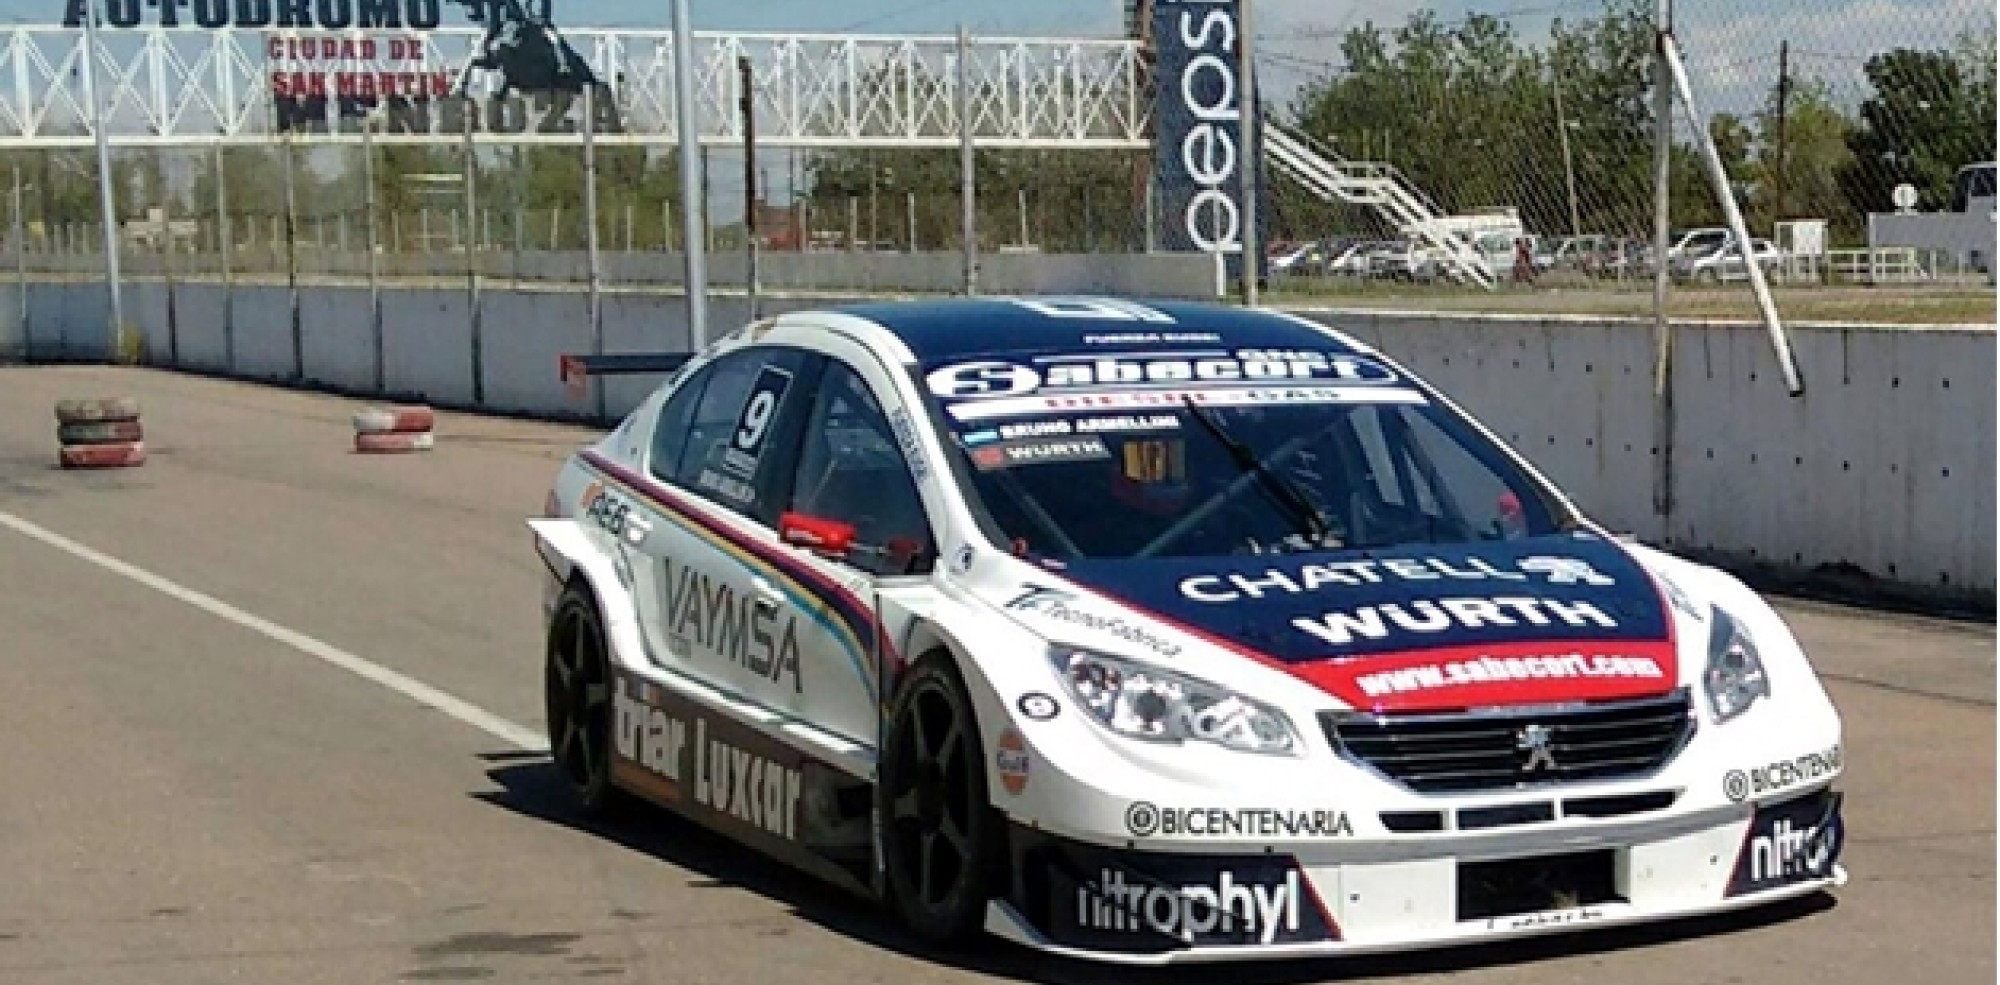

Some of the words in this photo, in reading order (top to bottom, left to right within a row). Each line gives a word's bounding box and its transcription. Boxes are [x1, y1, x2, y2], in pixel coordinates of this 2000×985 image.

[63, 0, 442, 29] AUTODROMO
[269, 37, 376, 60] CIUDAD
[388, 39, 424, 60] DE
[273, 71, 326, 97] SAN
[1169, 0, 1244, 252] peps
[738, 390, 775, 449] 9
[1000, 418, 1072, 439] BRUNO
[1004, 440, 1108, 461] WURTH
[1179, 558, 1527, 602] CHATELL
[664, 555, 804, 694] VAYMSA
[1291, 596, 1619, 644] WURTH
[694, 716, 804, 841] Luxcar
[1161, 807, 1354, 837] BICENTENARIA
[1076, 866, 1300, 945] nitrophyl
